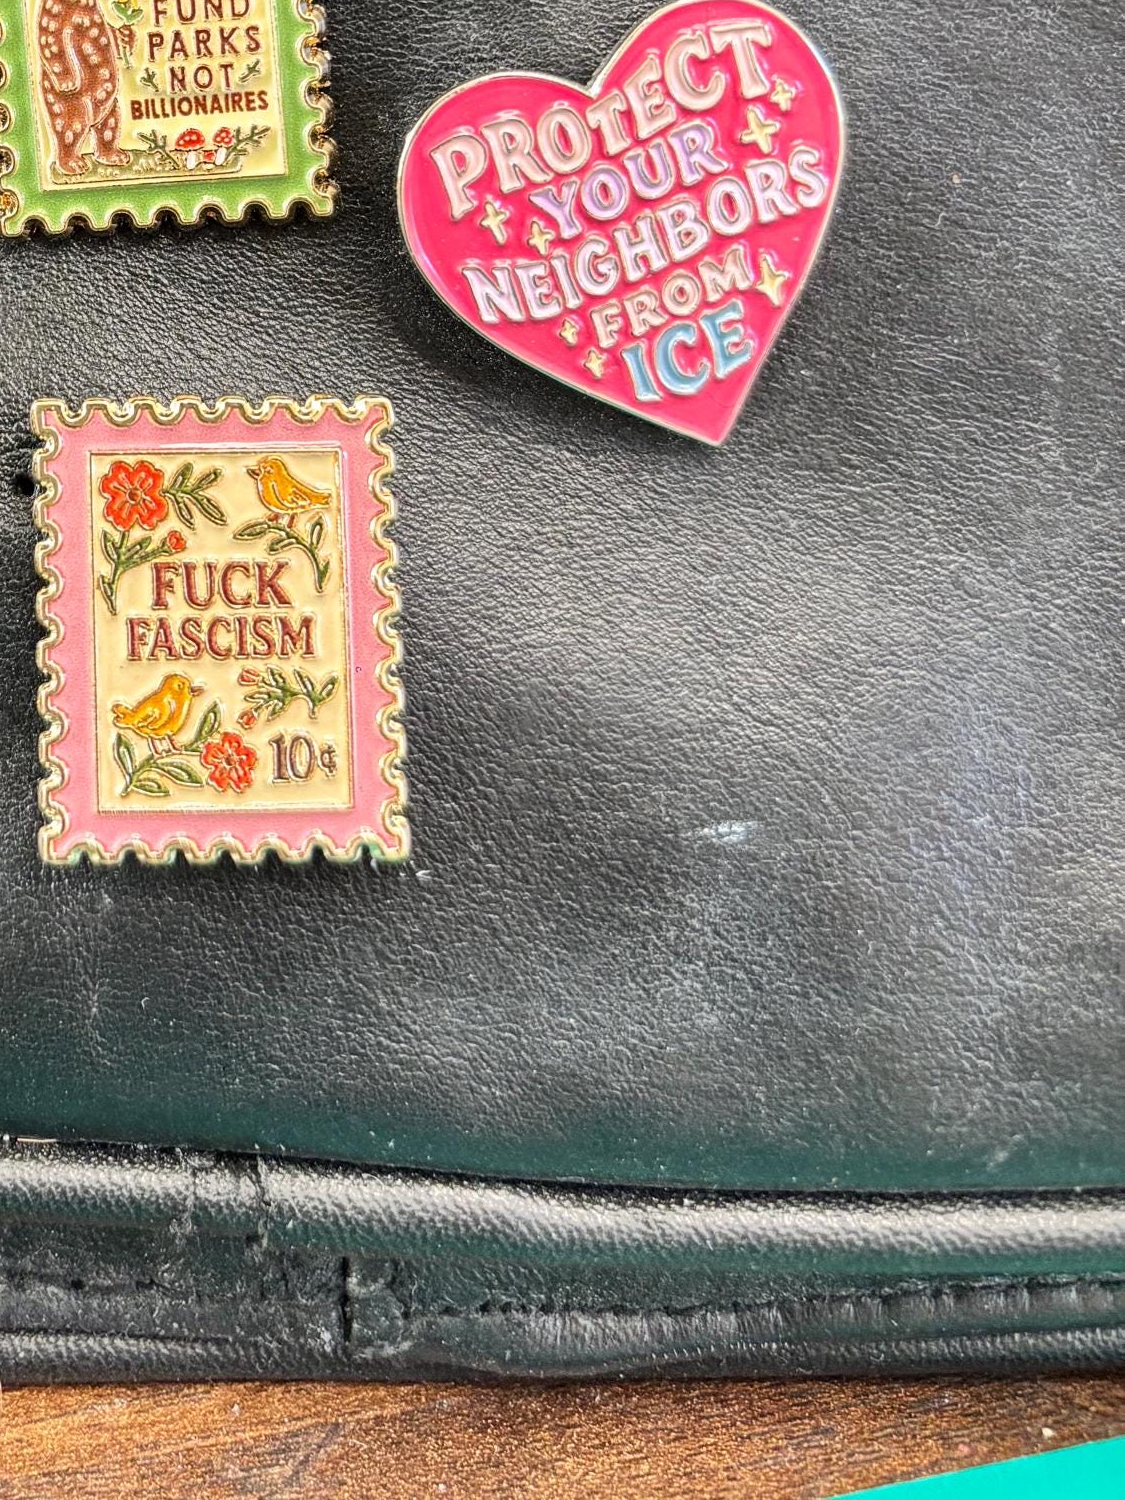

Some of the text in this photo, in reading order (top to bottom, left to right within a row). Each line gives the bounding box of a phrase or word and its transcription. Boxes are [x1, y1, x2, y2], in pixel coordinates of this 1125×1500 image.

[147, 25, 261, 61] PARKS
[130, 90, 269, 121] BILLIONAIRES
[168, 63, 234, 93] NOT
[431, 22, 772, 220] PROTECT
[530, 121, 728, 240] YOUR
[463, 148, 826, 324] NEIGHBORS
[594, 247, 754, 348] FROM
[622, 299, 754, 402] ICE
[151, 560, 295, 609] FUCK
[127, 615, 317, 661] FASCISM
[269, 729, 338, 784] 10¢
